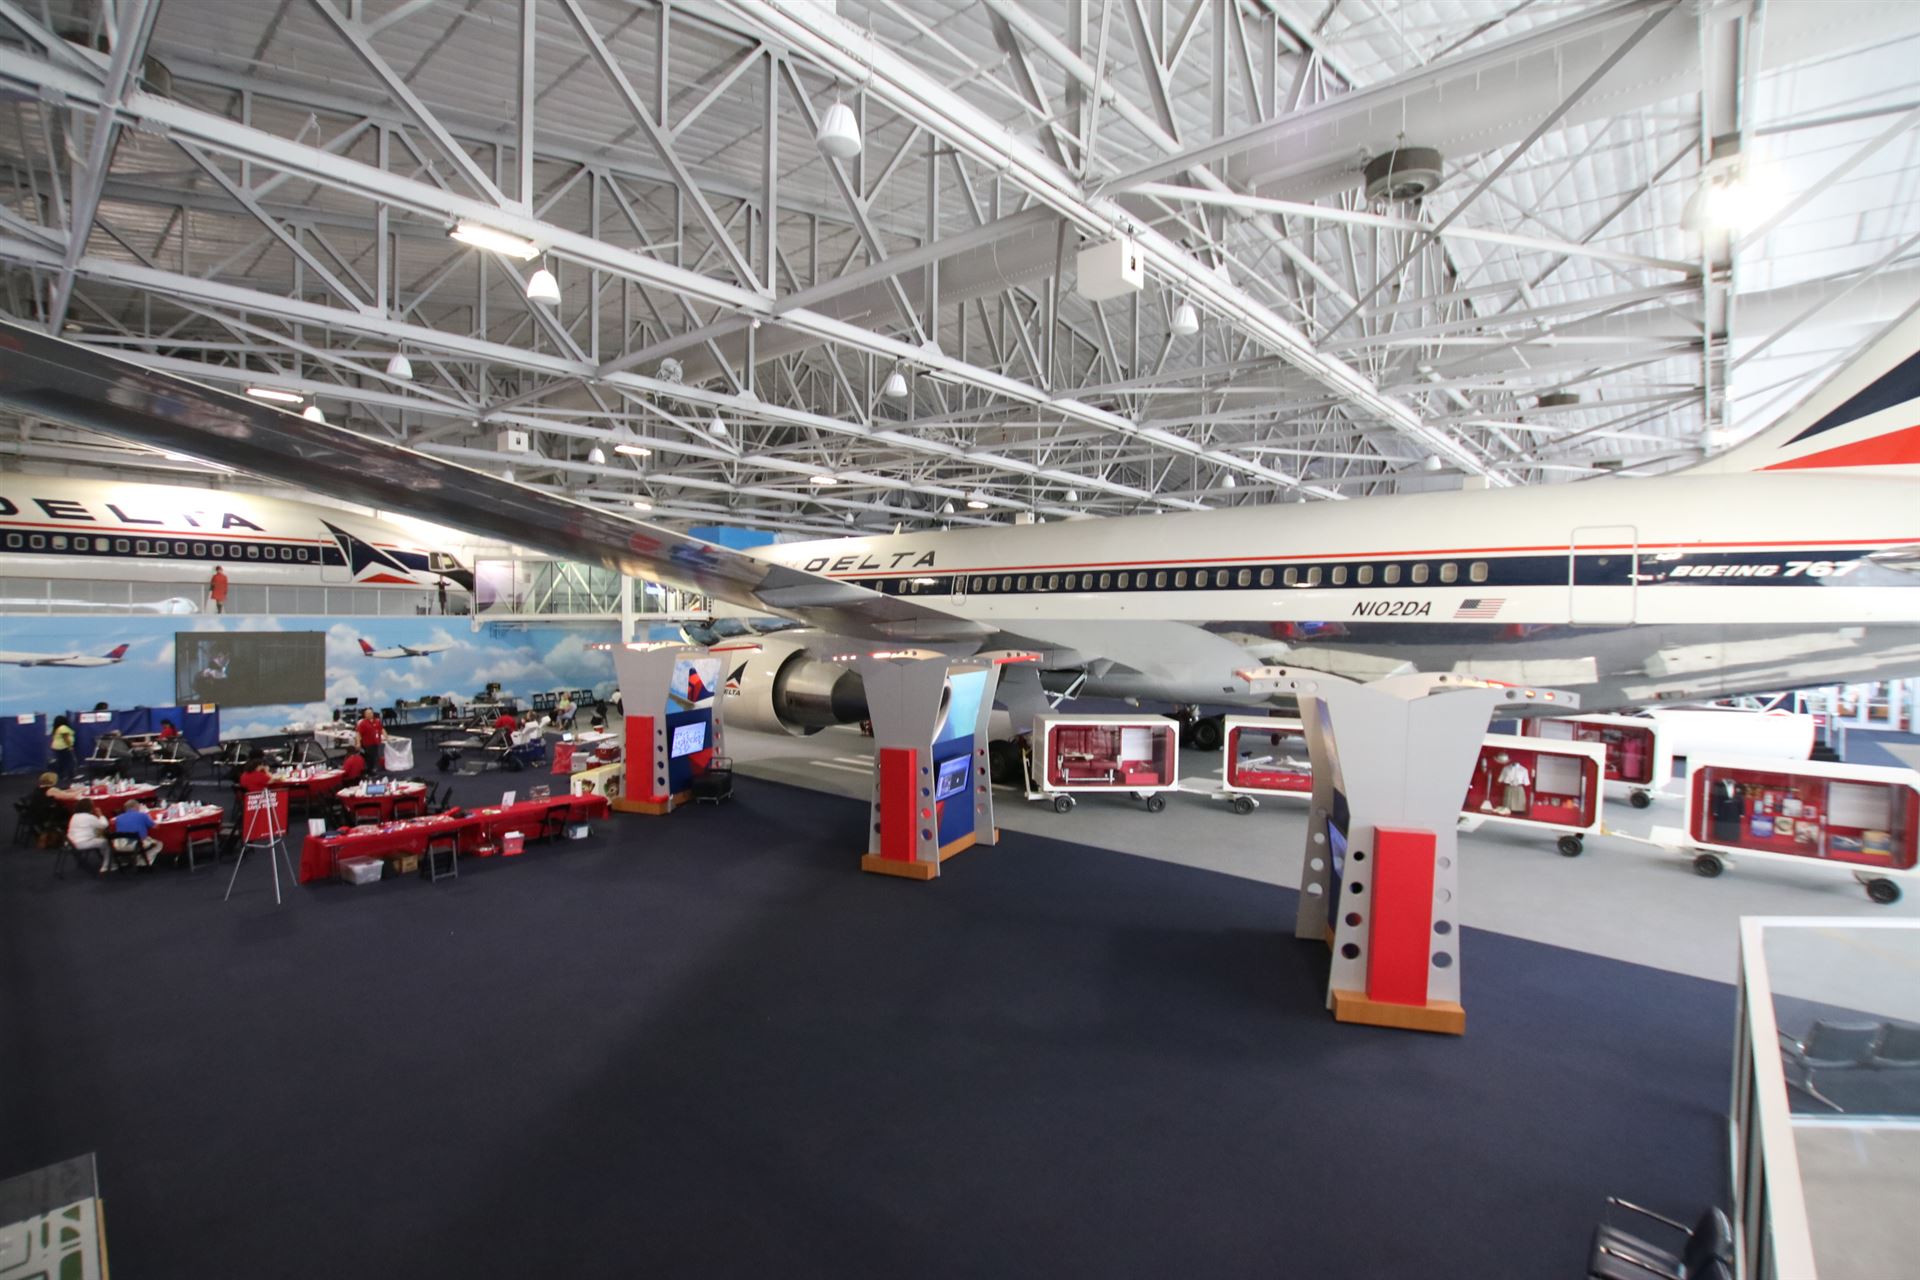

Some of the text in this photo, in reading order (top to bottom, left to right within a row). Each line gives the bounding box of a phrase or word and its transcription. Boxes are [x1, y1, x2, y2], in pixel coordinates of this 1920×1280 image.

[0, 496, 267, 532] ELA
[803, 550, 936, 572] DELTA
[1669, 560, 1861, 577] BOEING 767
[1351, 601, 1432, 616] N102DA
